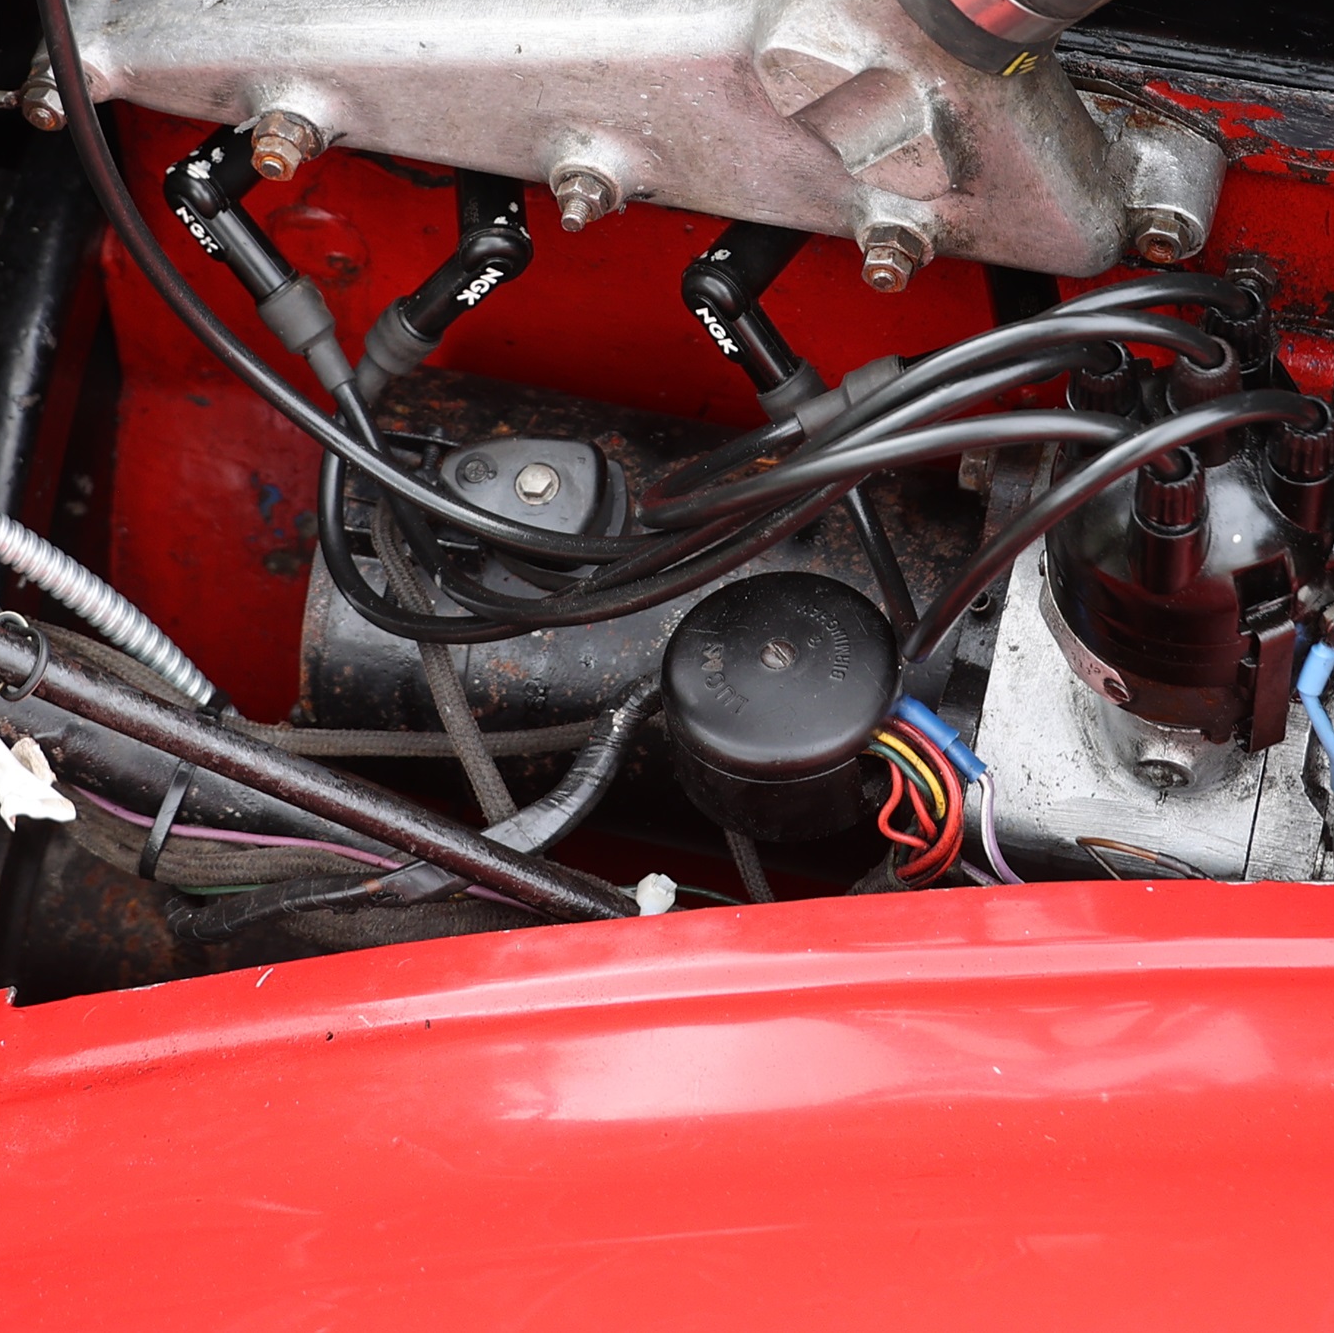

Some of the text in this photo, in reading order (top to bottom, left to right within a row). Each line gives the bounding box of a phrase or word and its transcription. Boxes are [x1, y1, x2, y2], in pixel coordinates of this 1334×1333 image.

[175, 205, 219, 254] NGK
[456, 266, 504, 307] NGK
[695, 307, 739, 355] NGK
